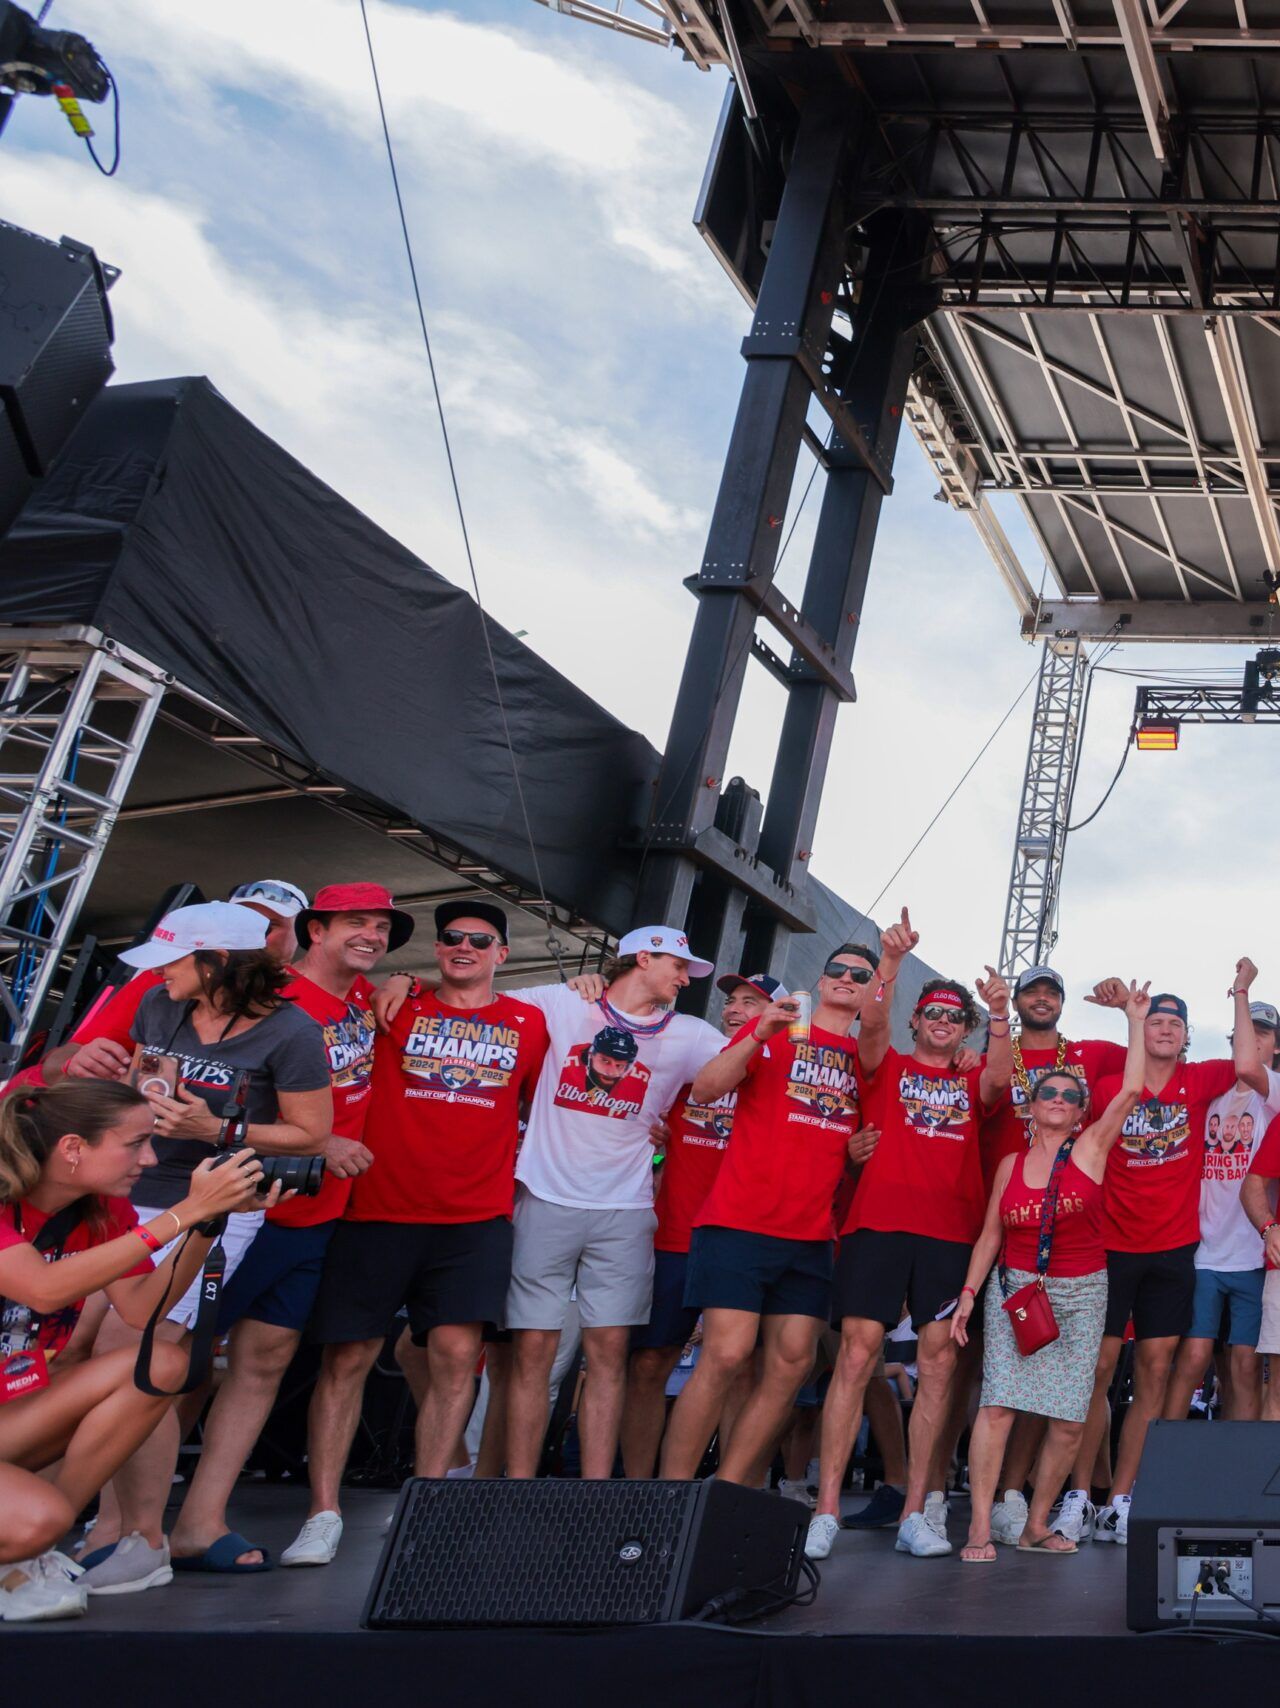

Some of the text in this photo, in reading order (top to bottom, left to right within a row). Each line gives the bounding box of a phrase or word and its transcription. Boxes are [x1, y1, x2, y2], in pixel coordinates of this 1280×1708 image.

[411, 1016, 520, 1048] REIGNING
[405, 1034, 518, 1070] CHAMPS
[409, 1060, 434, 1070] 2024
[481, 1069, 504, 1080] 2025
[405, 1088, 432, 1098] STANLEY
[433, 1091, 446, 1100] CUP
[557, 1083, 640, 1113] Elbo Room
[794, 1085, 813, 1096] 2024
[899, 1077, 969, 1110] CHAMPS
[1206, 1154, 1249, 1167] RING TH
[6, 1372, 40, 1391] MEDIA
